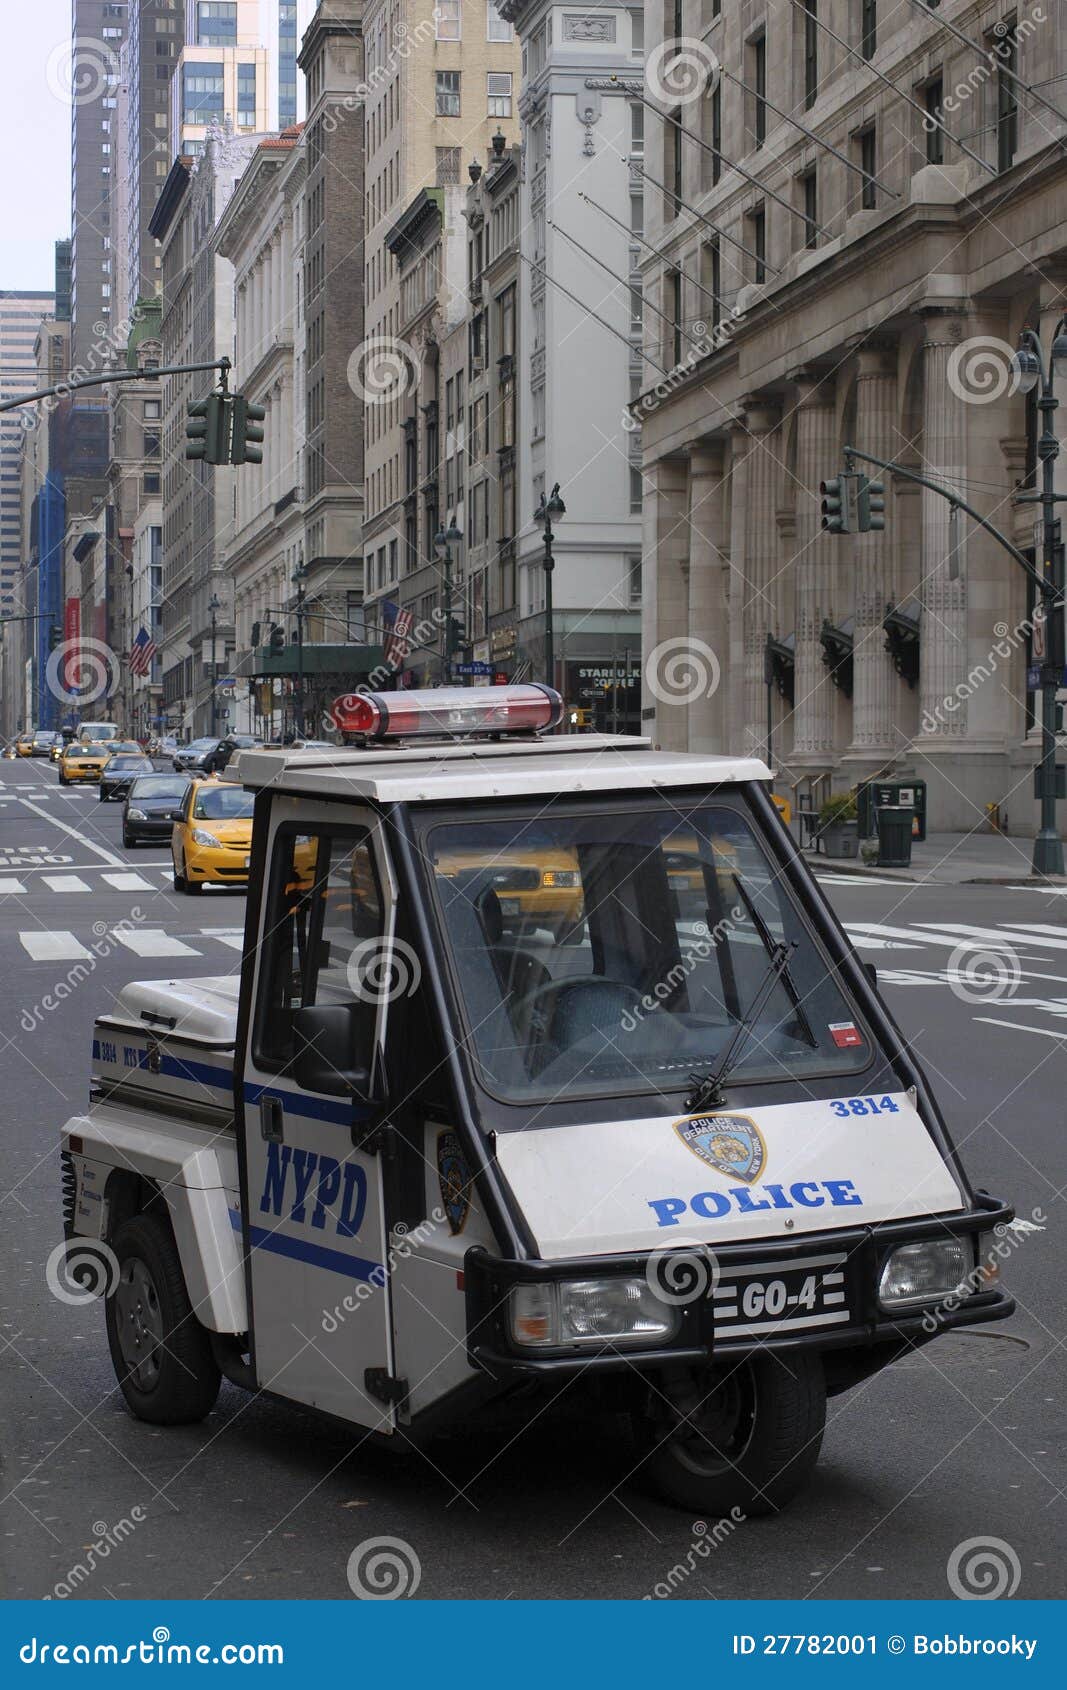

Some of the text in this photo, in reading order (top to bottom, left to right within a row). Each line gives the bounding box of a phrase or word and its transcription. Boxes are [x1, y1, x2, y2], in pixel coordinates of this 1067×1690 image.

[579, 668, 641, 678] STARBUK
[102, 1041, 117, 1063] 3814
[830, 1095, 899, 1117] 3814
[683, 1125, 753, 1141] DEPARTMENT
[690, 1117, 734, 1129] POLICE
[752, 1137, 762, 1157] YORK
[694, 1147, 735, 1173] CITY OF
[260, 1143, 368, 1238] NYPD
[648, 1179, 863, 1228] POLICE
[741, 1274, 817, 1319] GO-4
